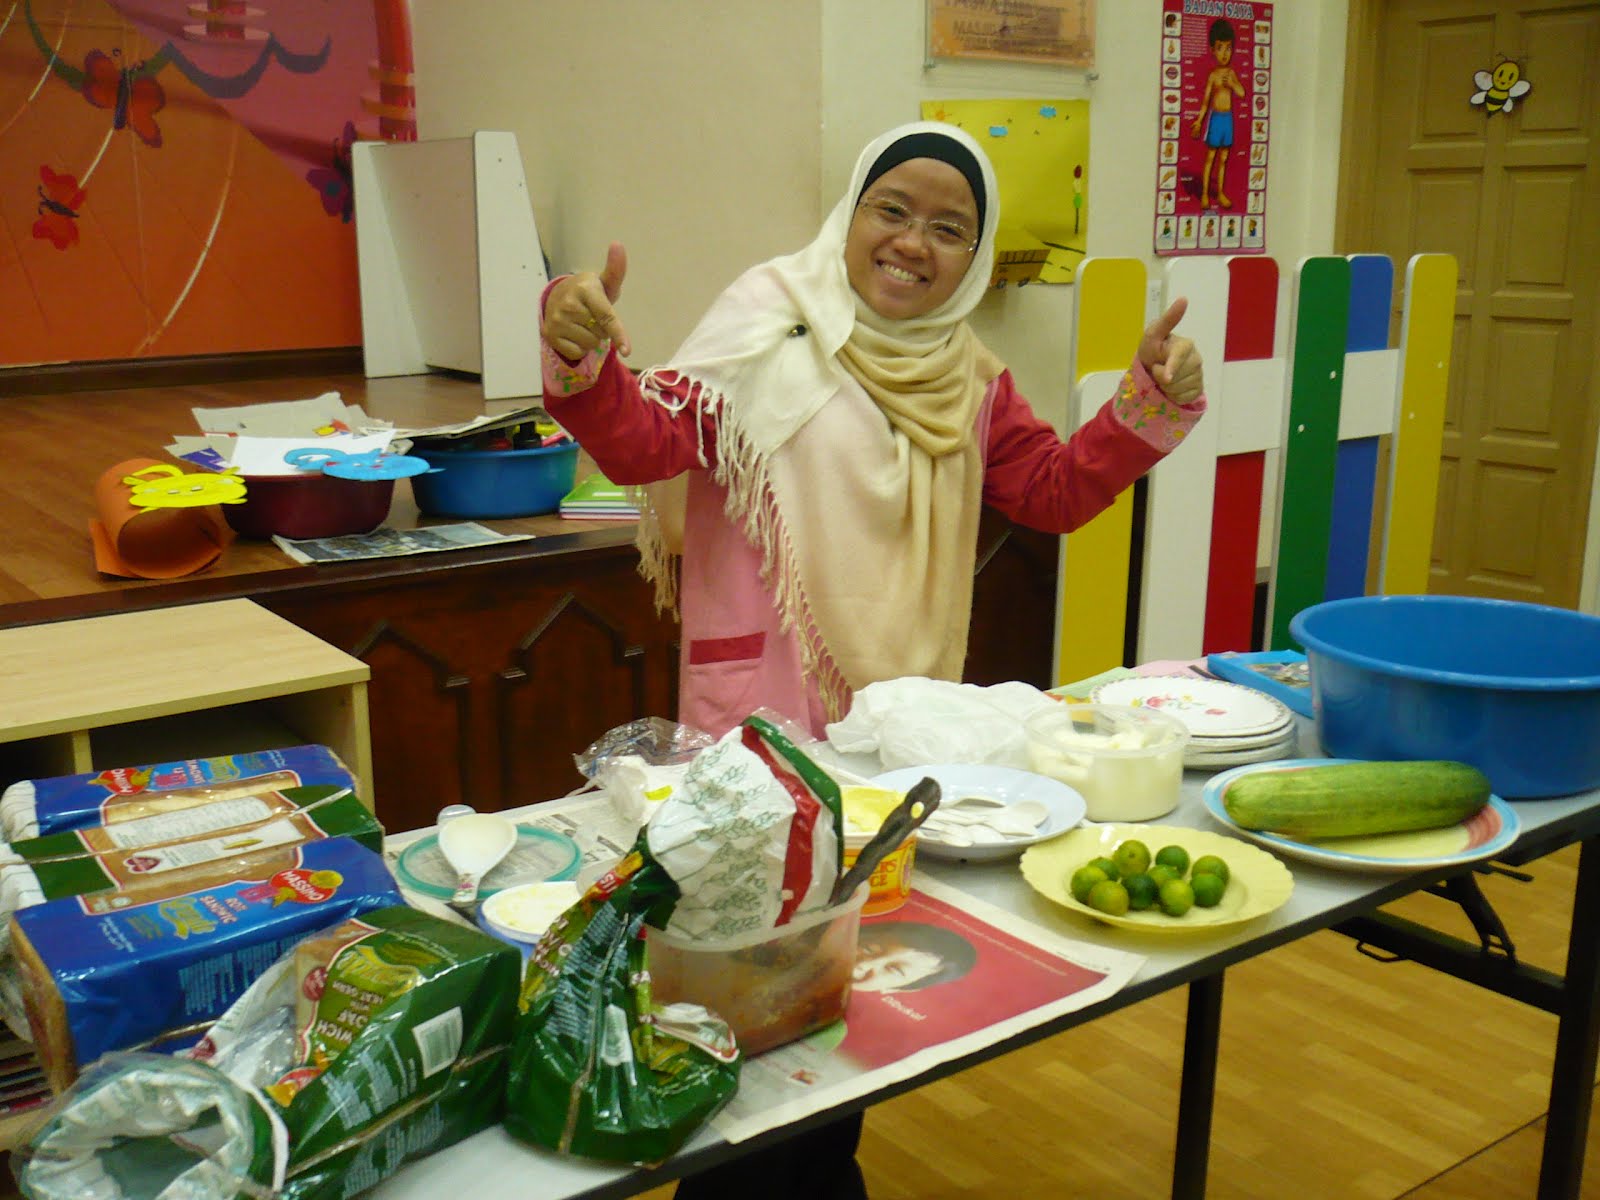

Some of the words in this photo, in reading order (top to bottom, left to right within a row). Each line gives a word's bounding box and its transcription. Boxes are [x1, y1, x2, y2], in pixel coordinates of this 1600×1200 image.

[1184, 0, 1223, 17] BADAN
[1225, 2, 1255, 20] SAYA
[281, 870, 325, 901] MASSIMO
[315, 1019, 353, 1044] WICH
